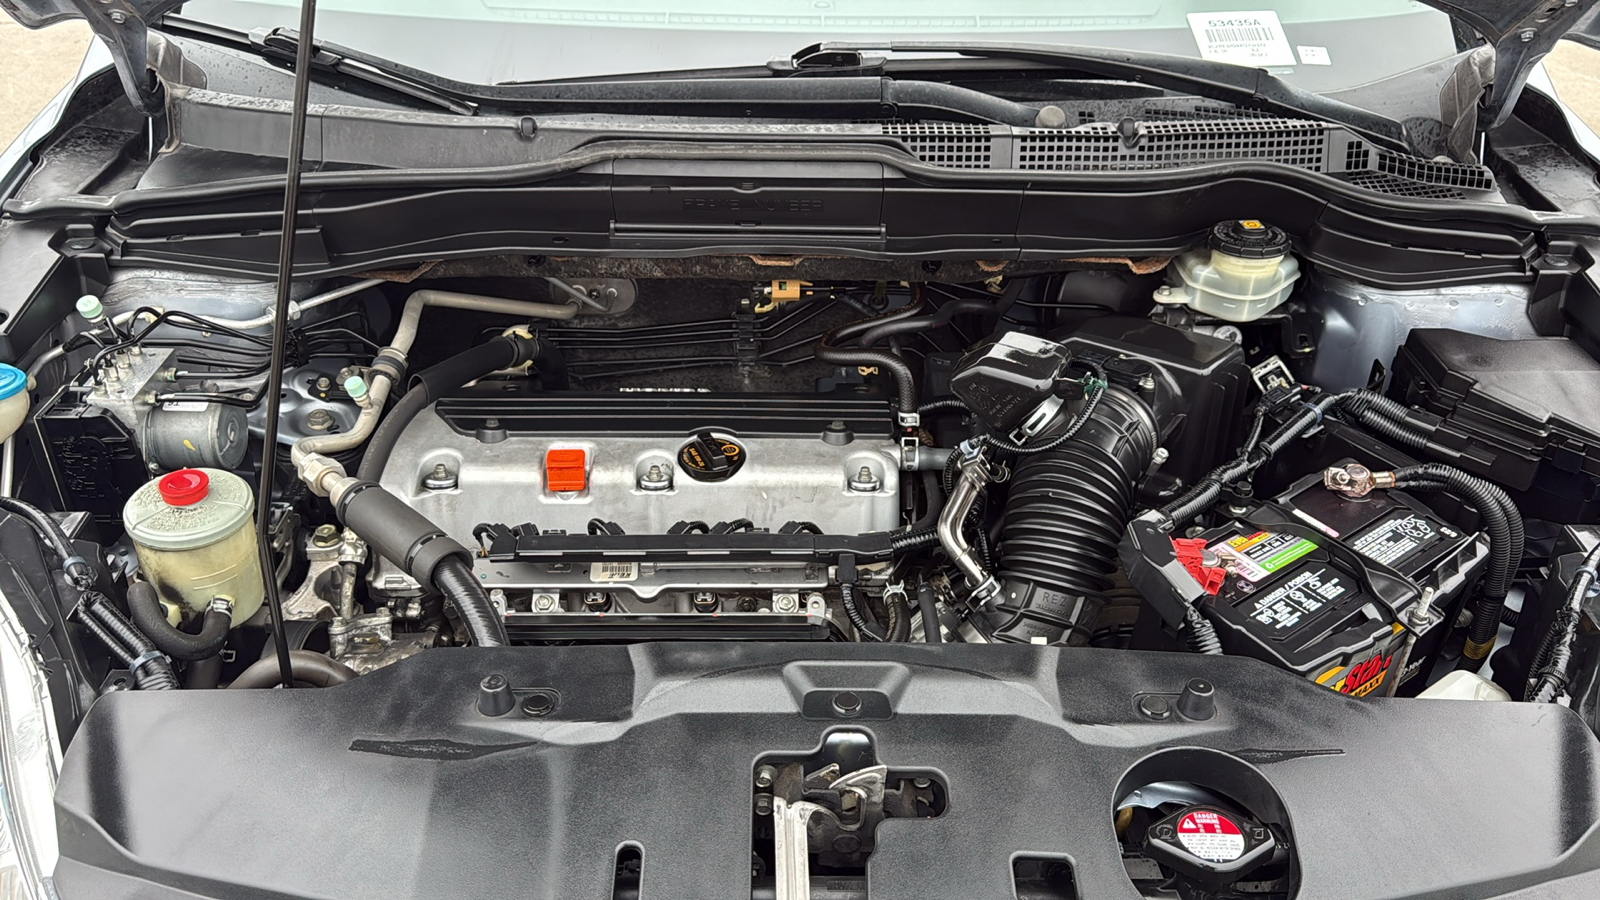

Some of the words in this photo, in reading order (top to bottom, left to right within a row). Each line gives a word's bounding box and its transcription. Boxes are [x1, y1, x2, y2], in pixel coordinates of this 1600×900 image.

[1042, 591, 1068, 607] REZ
[1260, 587, 1287, 605] DANGER
[1288, 571, 1314, 588] POISON
